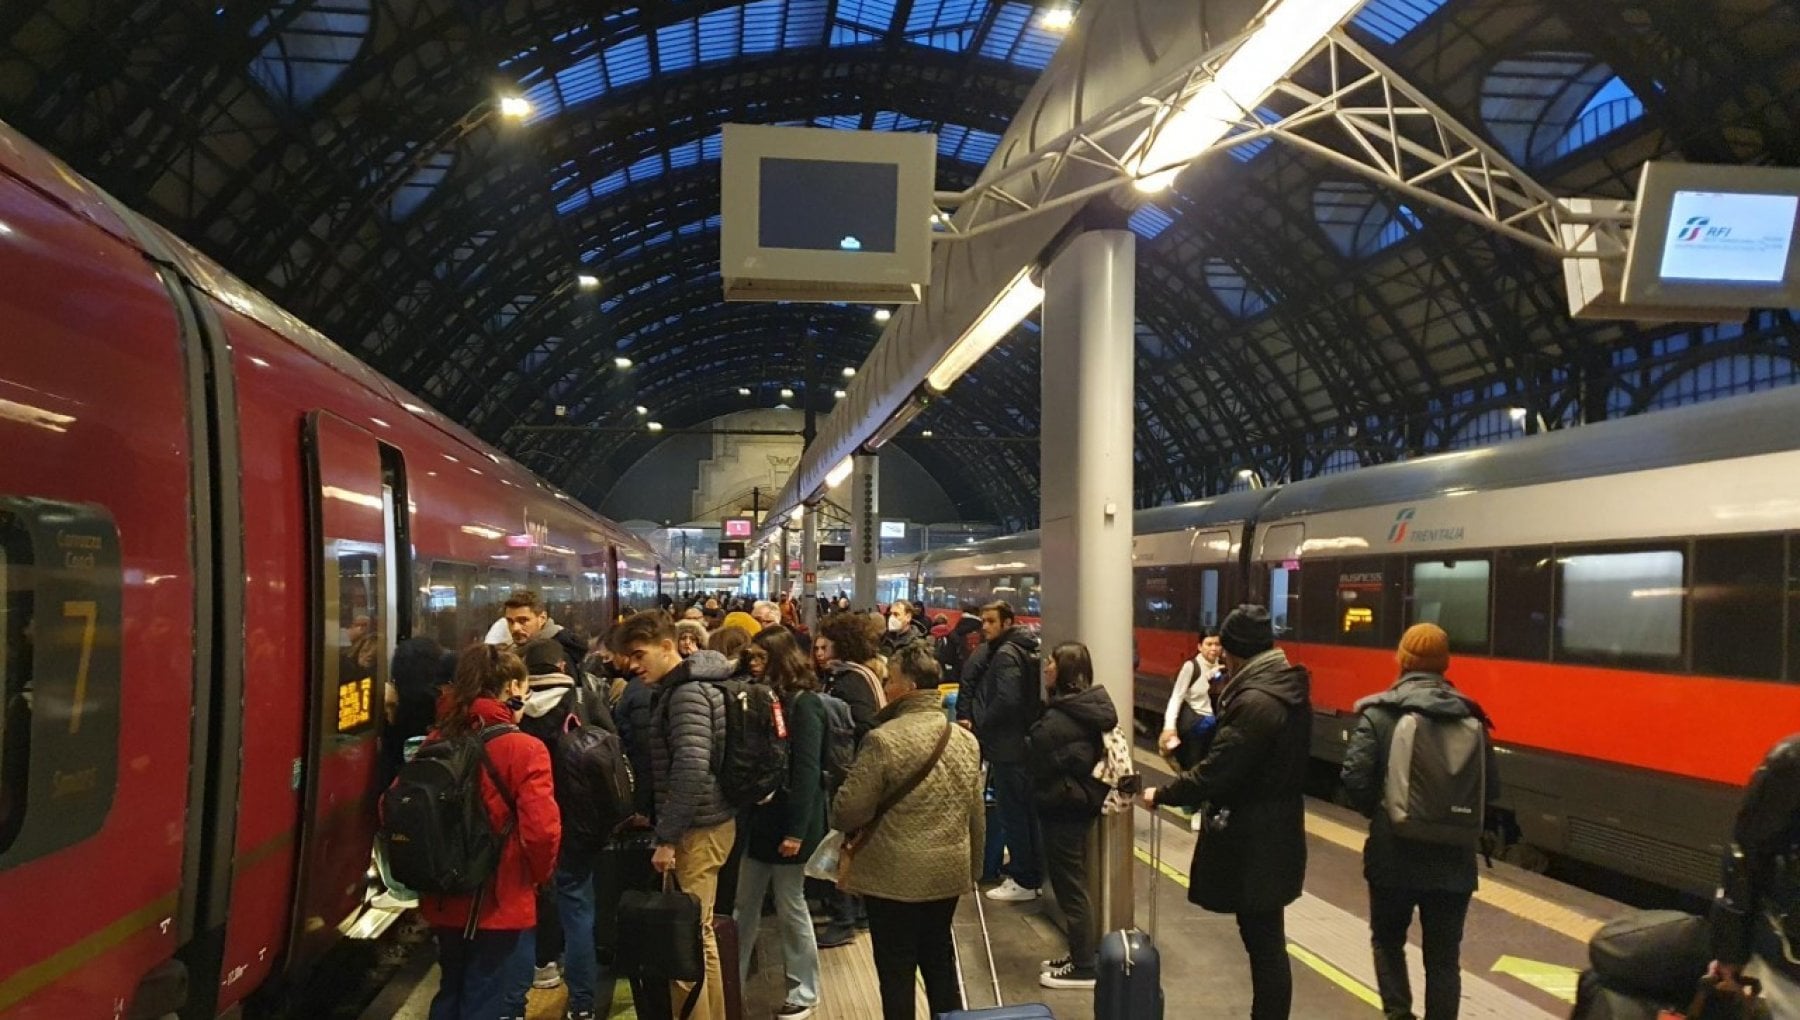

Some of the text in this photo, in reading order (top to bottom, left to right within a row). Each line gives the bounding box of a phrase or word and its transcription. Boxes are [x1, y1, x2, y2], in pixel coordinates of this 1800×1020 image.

[1706, 226, 1732, 238] RFI
[1411, 527, 1464, 542] TRENITALIA
[63, 601, 97, 734] 7
